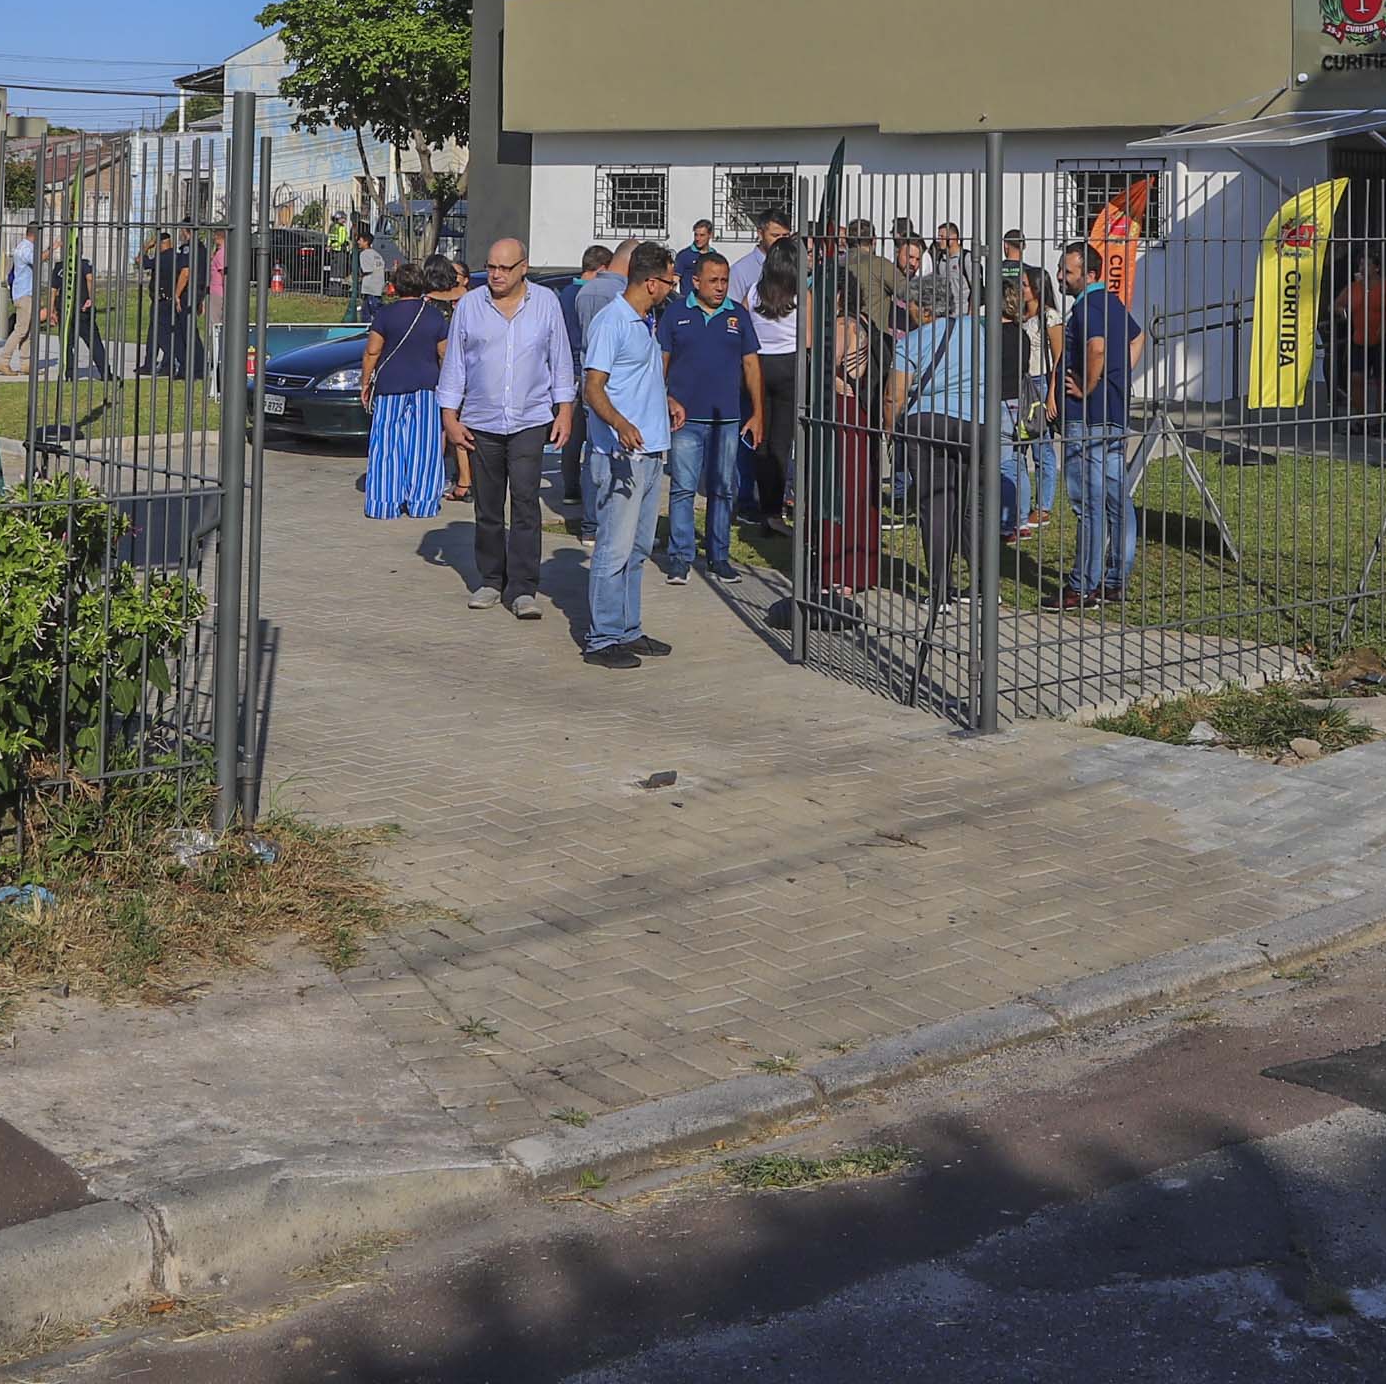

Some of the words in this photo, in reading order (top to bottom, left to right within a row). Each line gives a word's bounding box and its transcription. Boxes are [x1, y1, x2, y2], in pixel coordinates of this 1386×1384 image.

[1345, 23, 1379, 33] CURITIBA
[1108, 254, 1123, 296] CURI
[1279, 270, 1302, 367] CURITIBA
